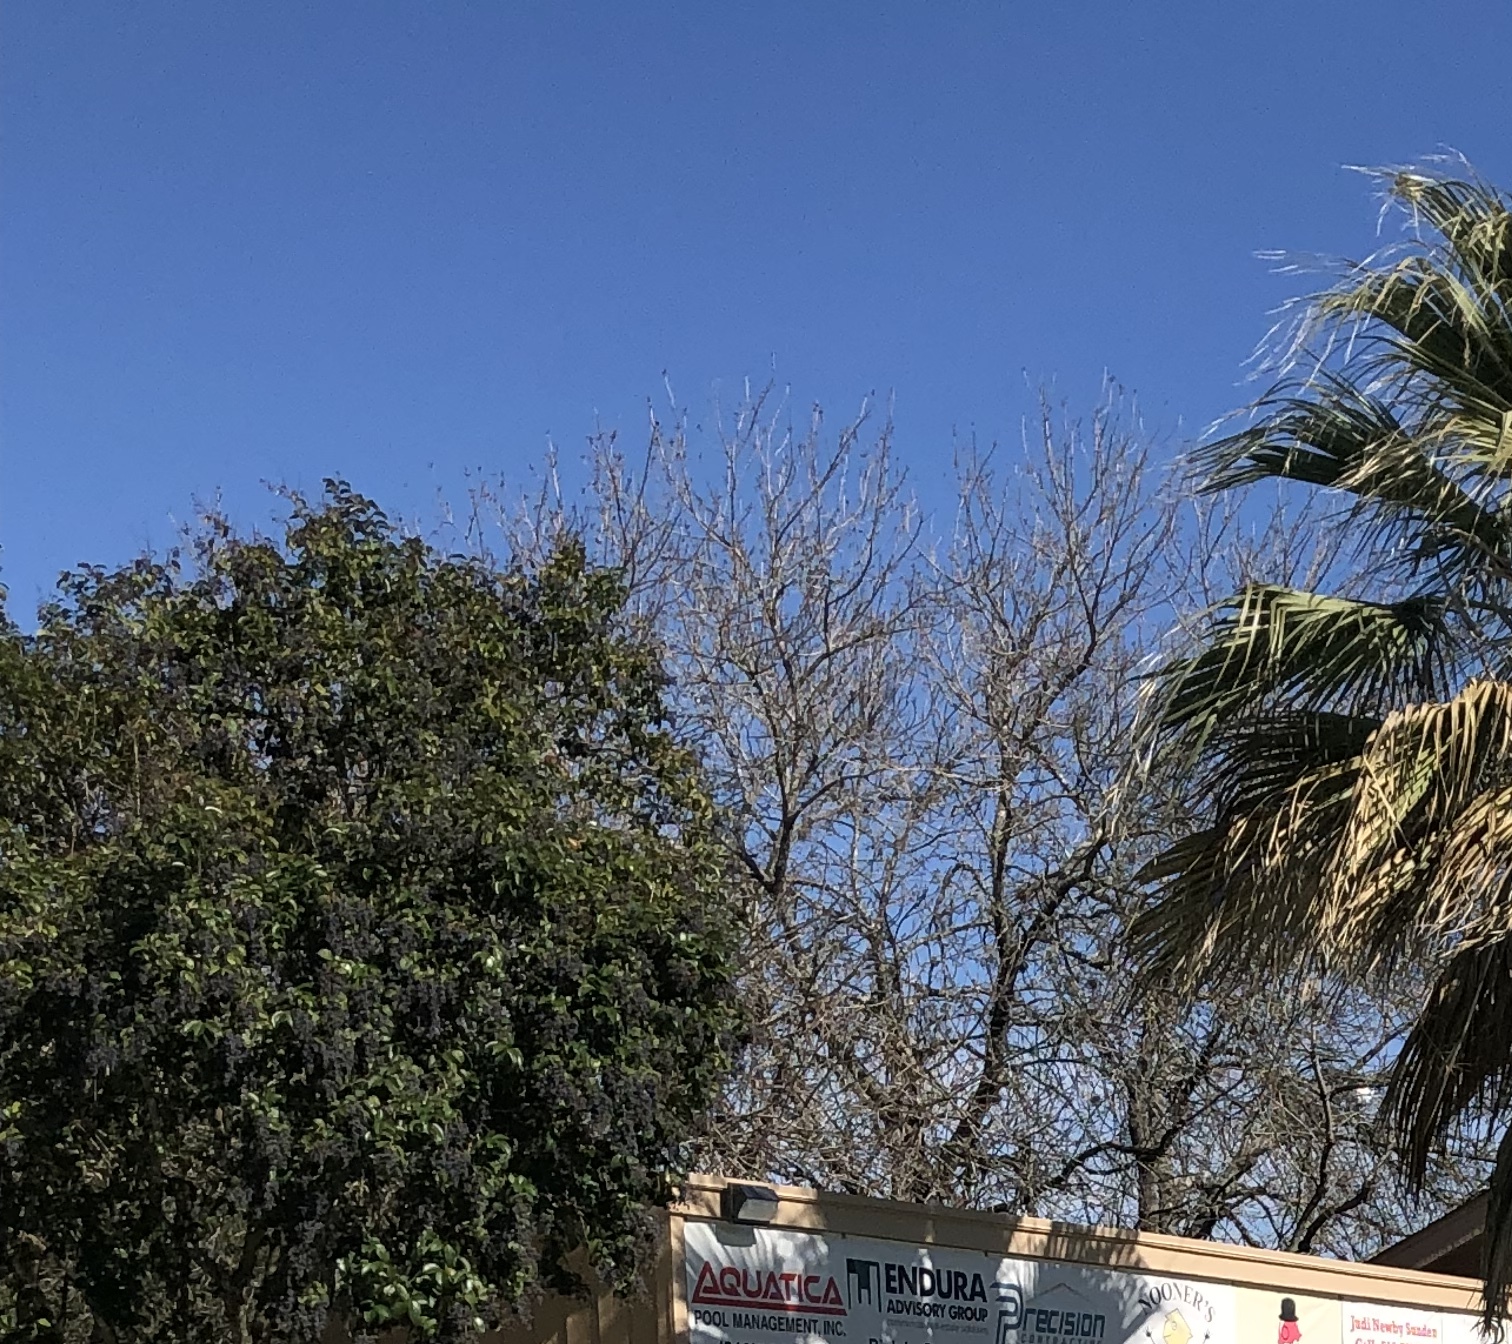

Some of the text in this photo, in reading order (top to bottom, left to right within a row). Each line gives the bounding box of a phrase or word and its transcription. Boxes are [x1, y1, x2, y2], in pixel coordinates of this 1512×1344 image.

[693, 1261, 844, 1306] AQUATICA
[885, 1263, 987, 1302] ENDURA
[887, 1299, 988, 1322] ADVISORY GROUP
[1138, 1282, 1215, 1323] NOONER'S
[694, 1310, 847, 1337] POOL MANAGEMENT, INC.
